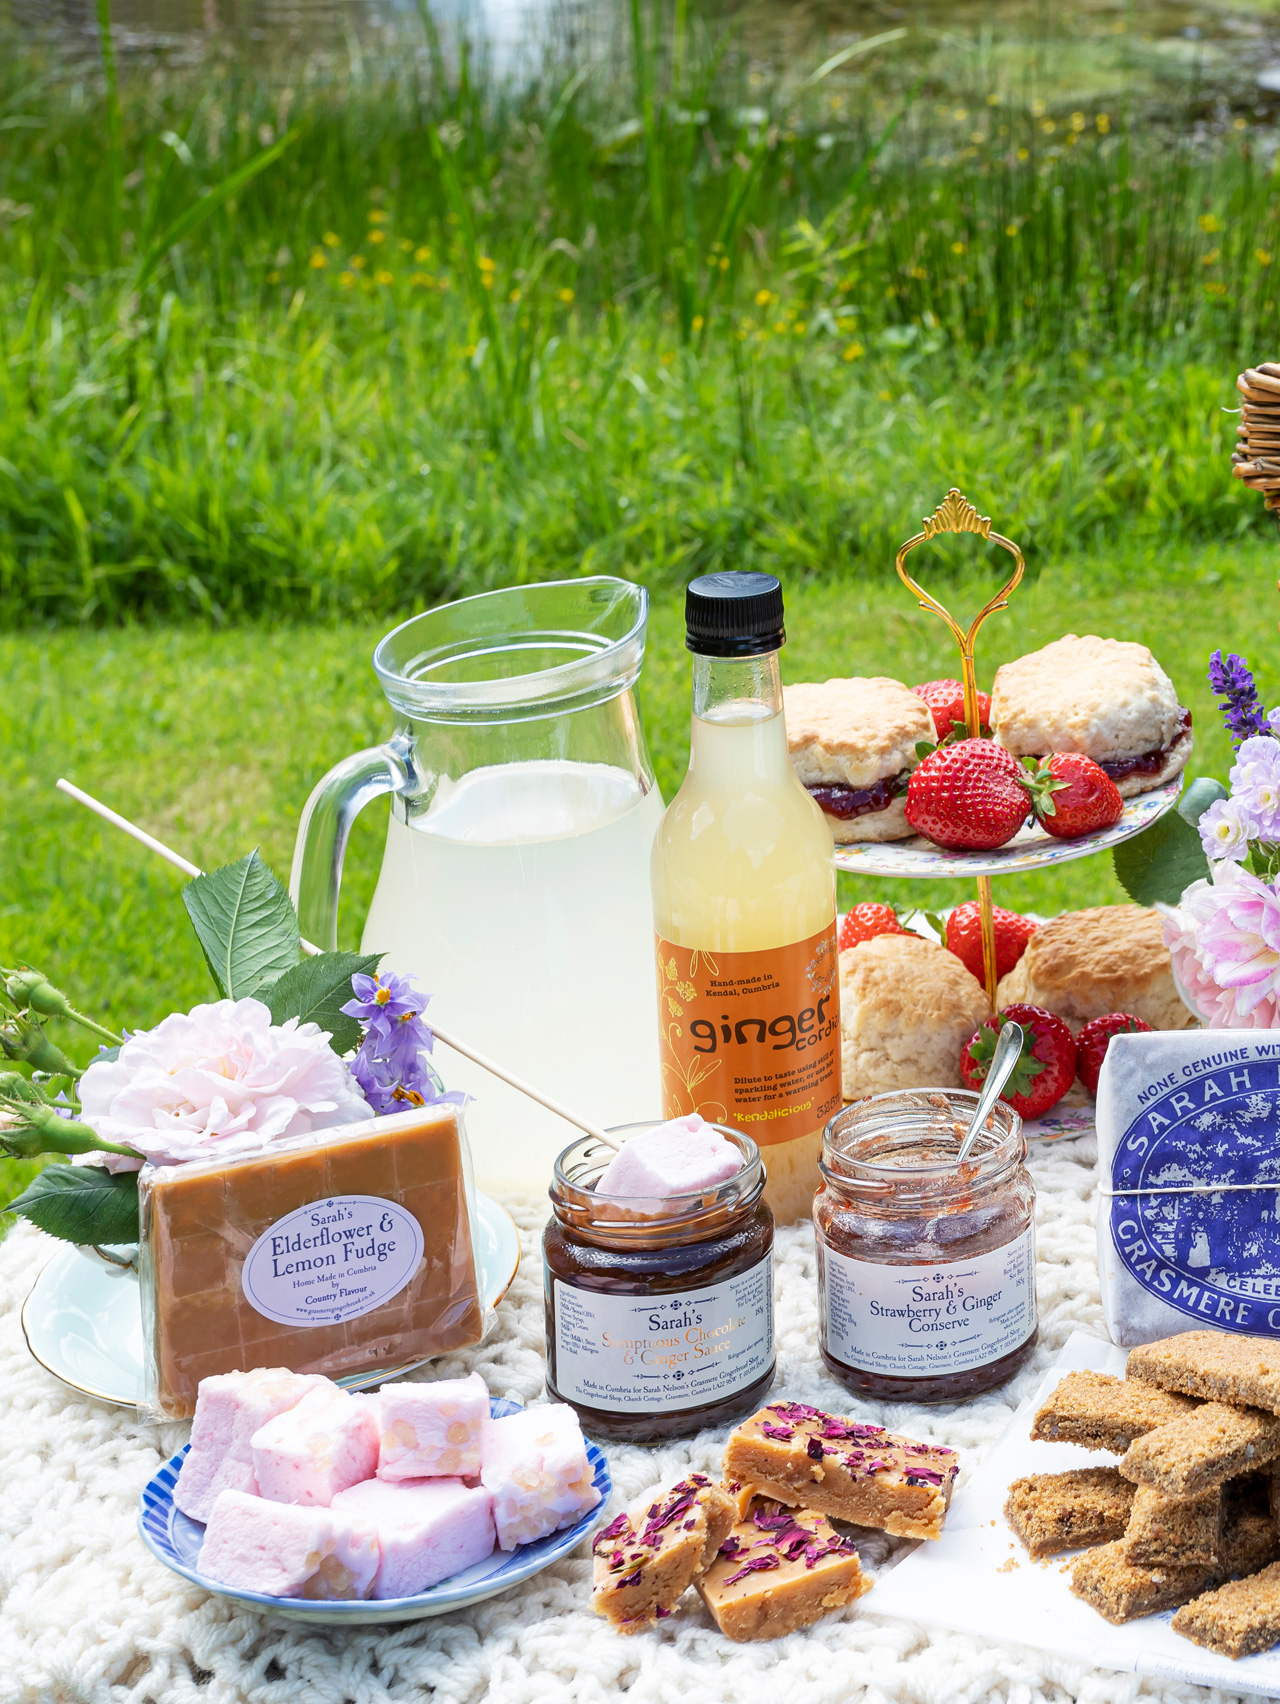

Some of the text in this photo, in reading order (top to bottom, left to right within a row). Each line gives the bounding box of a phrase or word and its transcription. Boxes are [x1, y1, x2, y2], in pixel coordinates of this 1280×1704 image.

[710, 976, 761, 987] Hand-made
[742, 982, 780, 994] Cumbria
[690, 994, 830, 1053] ginger
[775, 1070, 796, 1079] taste
[797, 1061, 817, 1074] using
[818, 1053, 829, 1064] still
[1137, 1073, 1178, 1104] NONE
[1182, 1047, 1249, 1077] GENUINE
[734, 1084, 778, 1094] sparkling
[779, 1078, 805, 1088] water,
[815, 1067, 825, 1075] use
[735, 1095, 762, 1103] water
[763, 1092, 776, 1100] for
[785, 1080, 819, 1096] warming
[1126, 1068, 1251, 1157] SARAH
[311, 1207, 353, 1226] Sarah's
[271, 1212, 394, 1257] Elderflower &
[272, 1238, 396, 1278] Lemon Fudge
[293, 1279, 315, 1288] Home
[317, 1273, 336, 1283] Made
[347, 1265, 377, 1276] Cumbria
[331, 1281, 339, 1289] by
[1118, 1220, 1252, 1325] GRASMERE
[305, 1286, 367, 1305] Country Flavour
[870, 1290, 1002, 1322] Strawberry & Ginger
[912, 1283, 964, 1302] Sarah's
[648, 1309, 702, 1331] Sarah's
[908, 1317, 969, 1332] Conserve
[601, 1316, 746, 1354] Sumptuous Chocolate
[851, 1345, 864, 1356] Made
[872, 1352, 896, 1361] Cumbria
[908, 1354, 925, 1362] Sarah
[927, 1352, 952, 1361] Nelson's
[953, 1347, 980, 1358] Grasmere
[981, 1333, 1009, 1350] Gingerbread
[1009, 1327, 1020, 1336] Shop
[623, 1350, 634, 1365] &
[640, 1350, 689, 1370] Ginger
[694, 1340, 731, 1359] Sauce
[583, 1379, 598, 1389] Made
[605, 1384, 631, 1393] Cumbria
[663, 1382, 689, 1392] Nelson's
[691, 1375, 718, 1387] Grasmere
[720, 1361, 748, 1379] Gingerbread
[749, 1355, 759, 1365] Shop
